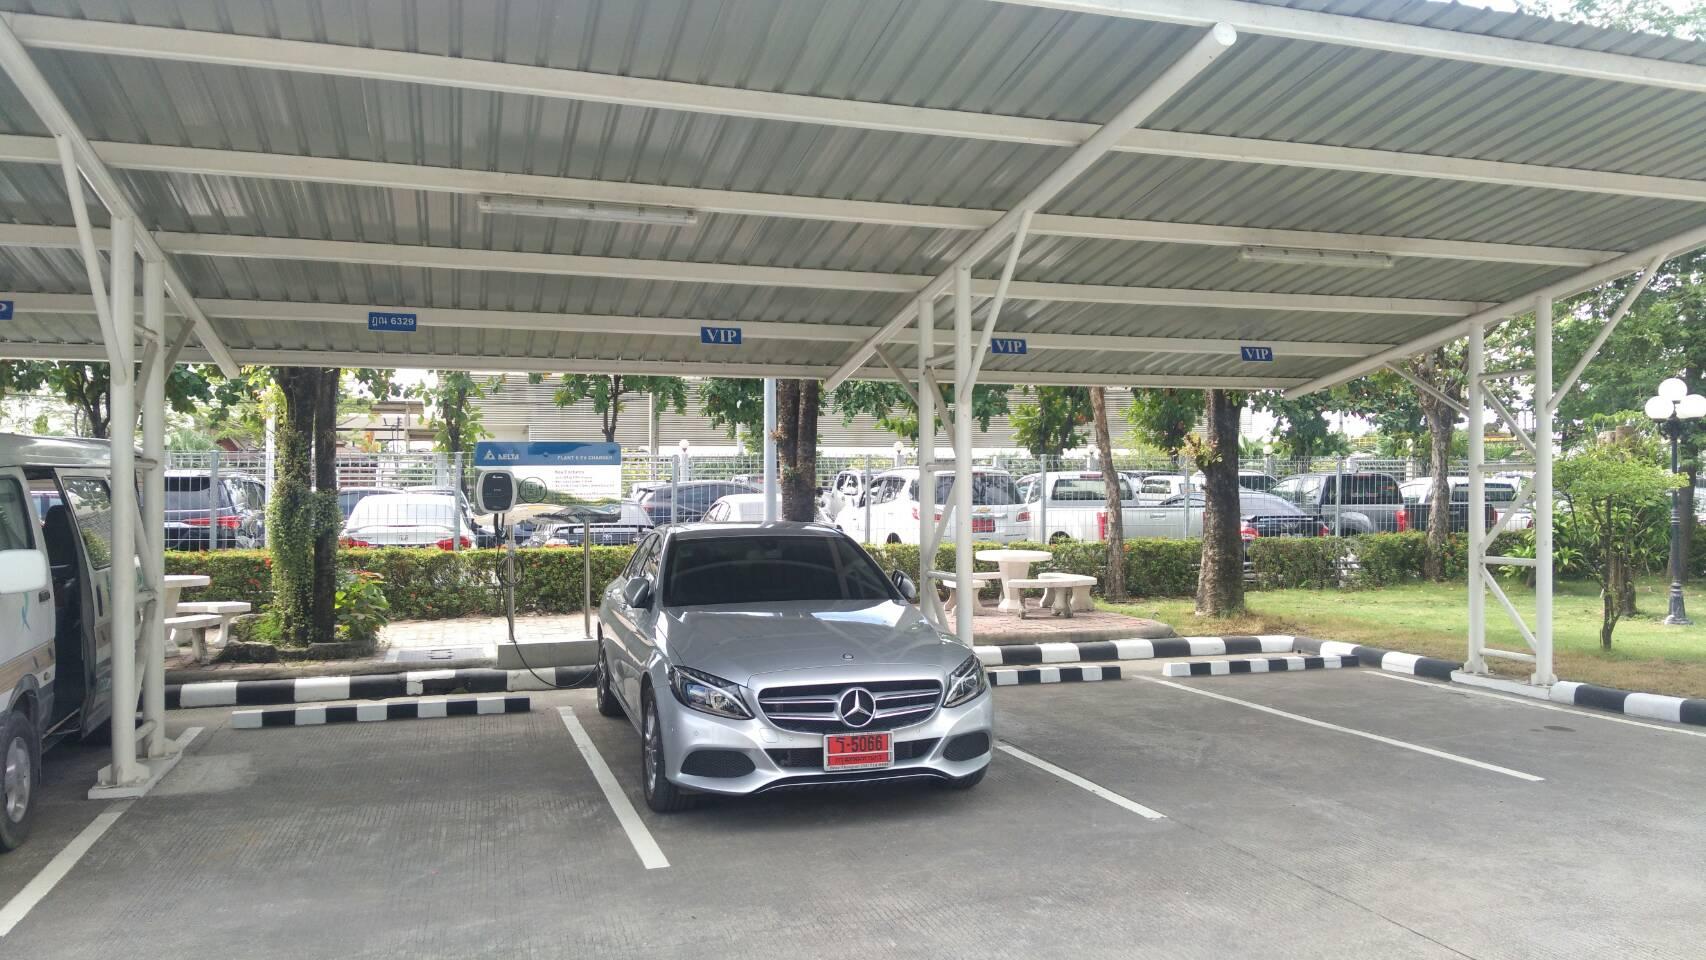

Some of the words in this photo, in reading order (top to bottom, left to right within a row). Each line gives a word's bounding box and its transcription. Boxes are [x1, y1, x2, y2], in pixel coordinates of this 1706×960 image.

[390, 317, 414, 326] 6329
[706, 328, 737, 343] VIP
[996, 339, 1022, 353] VIP
[1244, 348, 1269, 360] VIP
